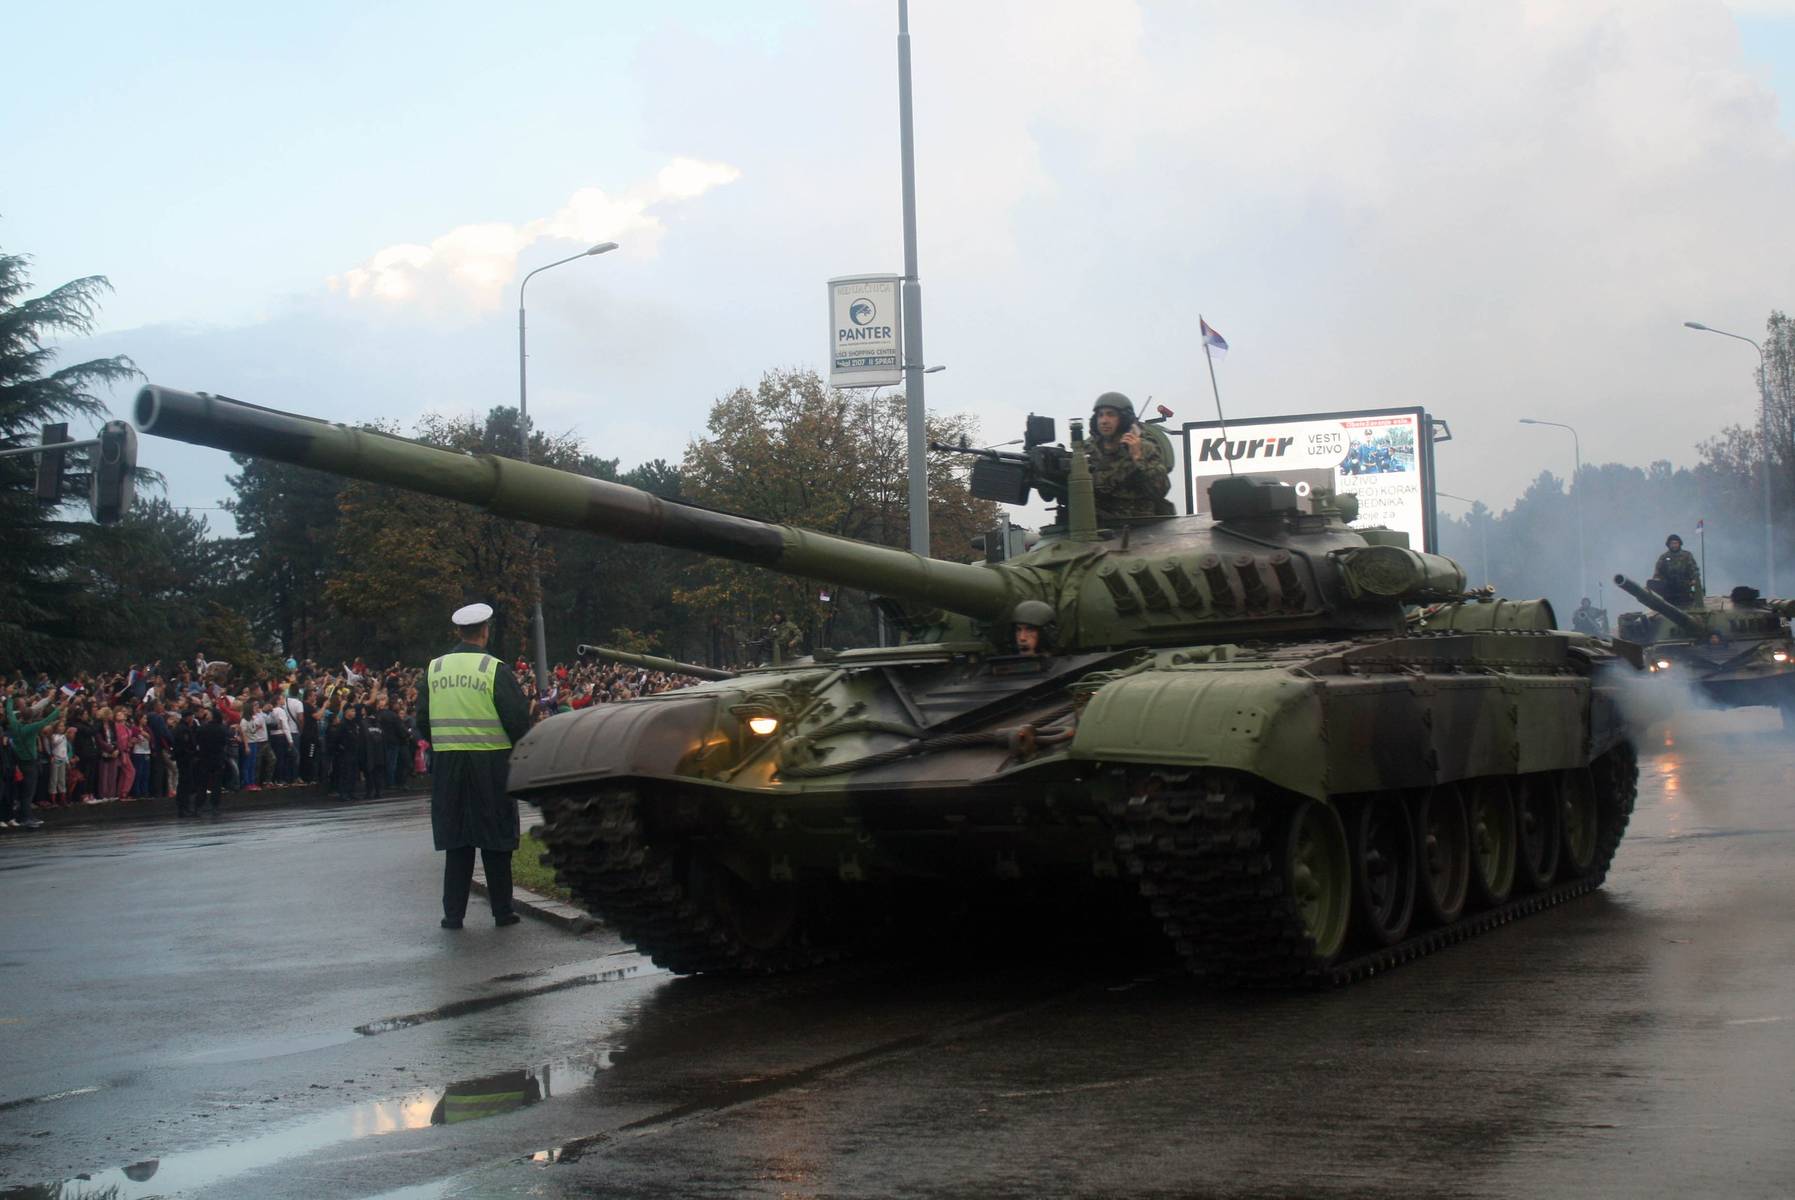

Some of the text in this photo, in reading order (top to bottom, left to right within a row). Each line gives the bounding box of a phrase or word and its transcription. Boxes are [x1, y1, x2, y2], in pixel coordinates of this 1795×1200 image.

[839, 326, 891, 341] PANTER
[1308, 433, 1341, 443] VESTI
[1199, 437, 1294, 461] Kurir
[1381, 485, 1418, 496] KORAK
[431, 675, 487, 695] POLICIJA
